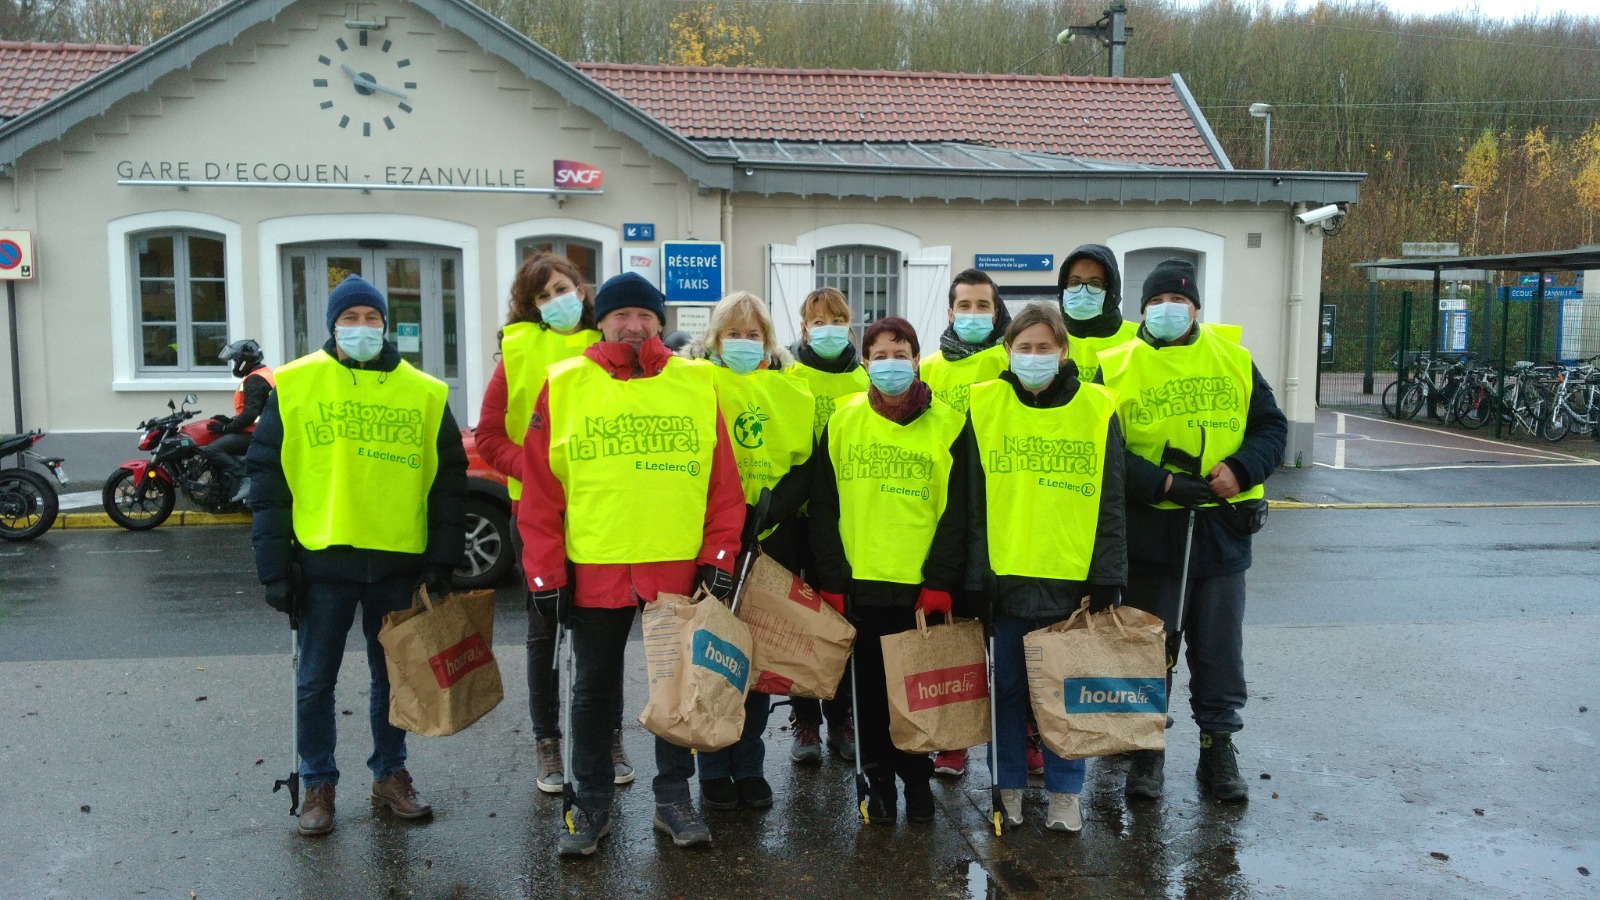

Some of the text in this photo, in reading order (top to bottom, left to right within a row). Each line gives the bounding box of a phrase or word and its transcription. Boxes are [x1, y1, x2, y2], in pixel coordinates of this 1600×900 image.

[117, 161, 190, 180] GARE
[205, 162, 349, 182] D'ECOUEN
[385, 166, 525, 187] EZANVILLE
[556, 169, 601, 183] SNCF
[668, 254, 718, 268] RÉSERVÉ
[676, 278, 709, 290] TAXIS
[1512, 289, 1533, 297] ÉCOUE
[1140, 376, 1235, 407] Nettoyons
[318, 400, 424, 425] Nettoyons
[1129, 388, 1239, 425] la nature!
[305, 417, 424, 448] la nature!
[585, 413, 696, 438] Nettoyons
[569, 428, 700, 461] la nature!
[848, 442, 934, 462] Nettoyons
[1004, 434, 1096, 456] Nettoyons
[838, 459, 934, 482] la nature!
[989, 450, 1098, 477] la nature!
